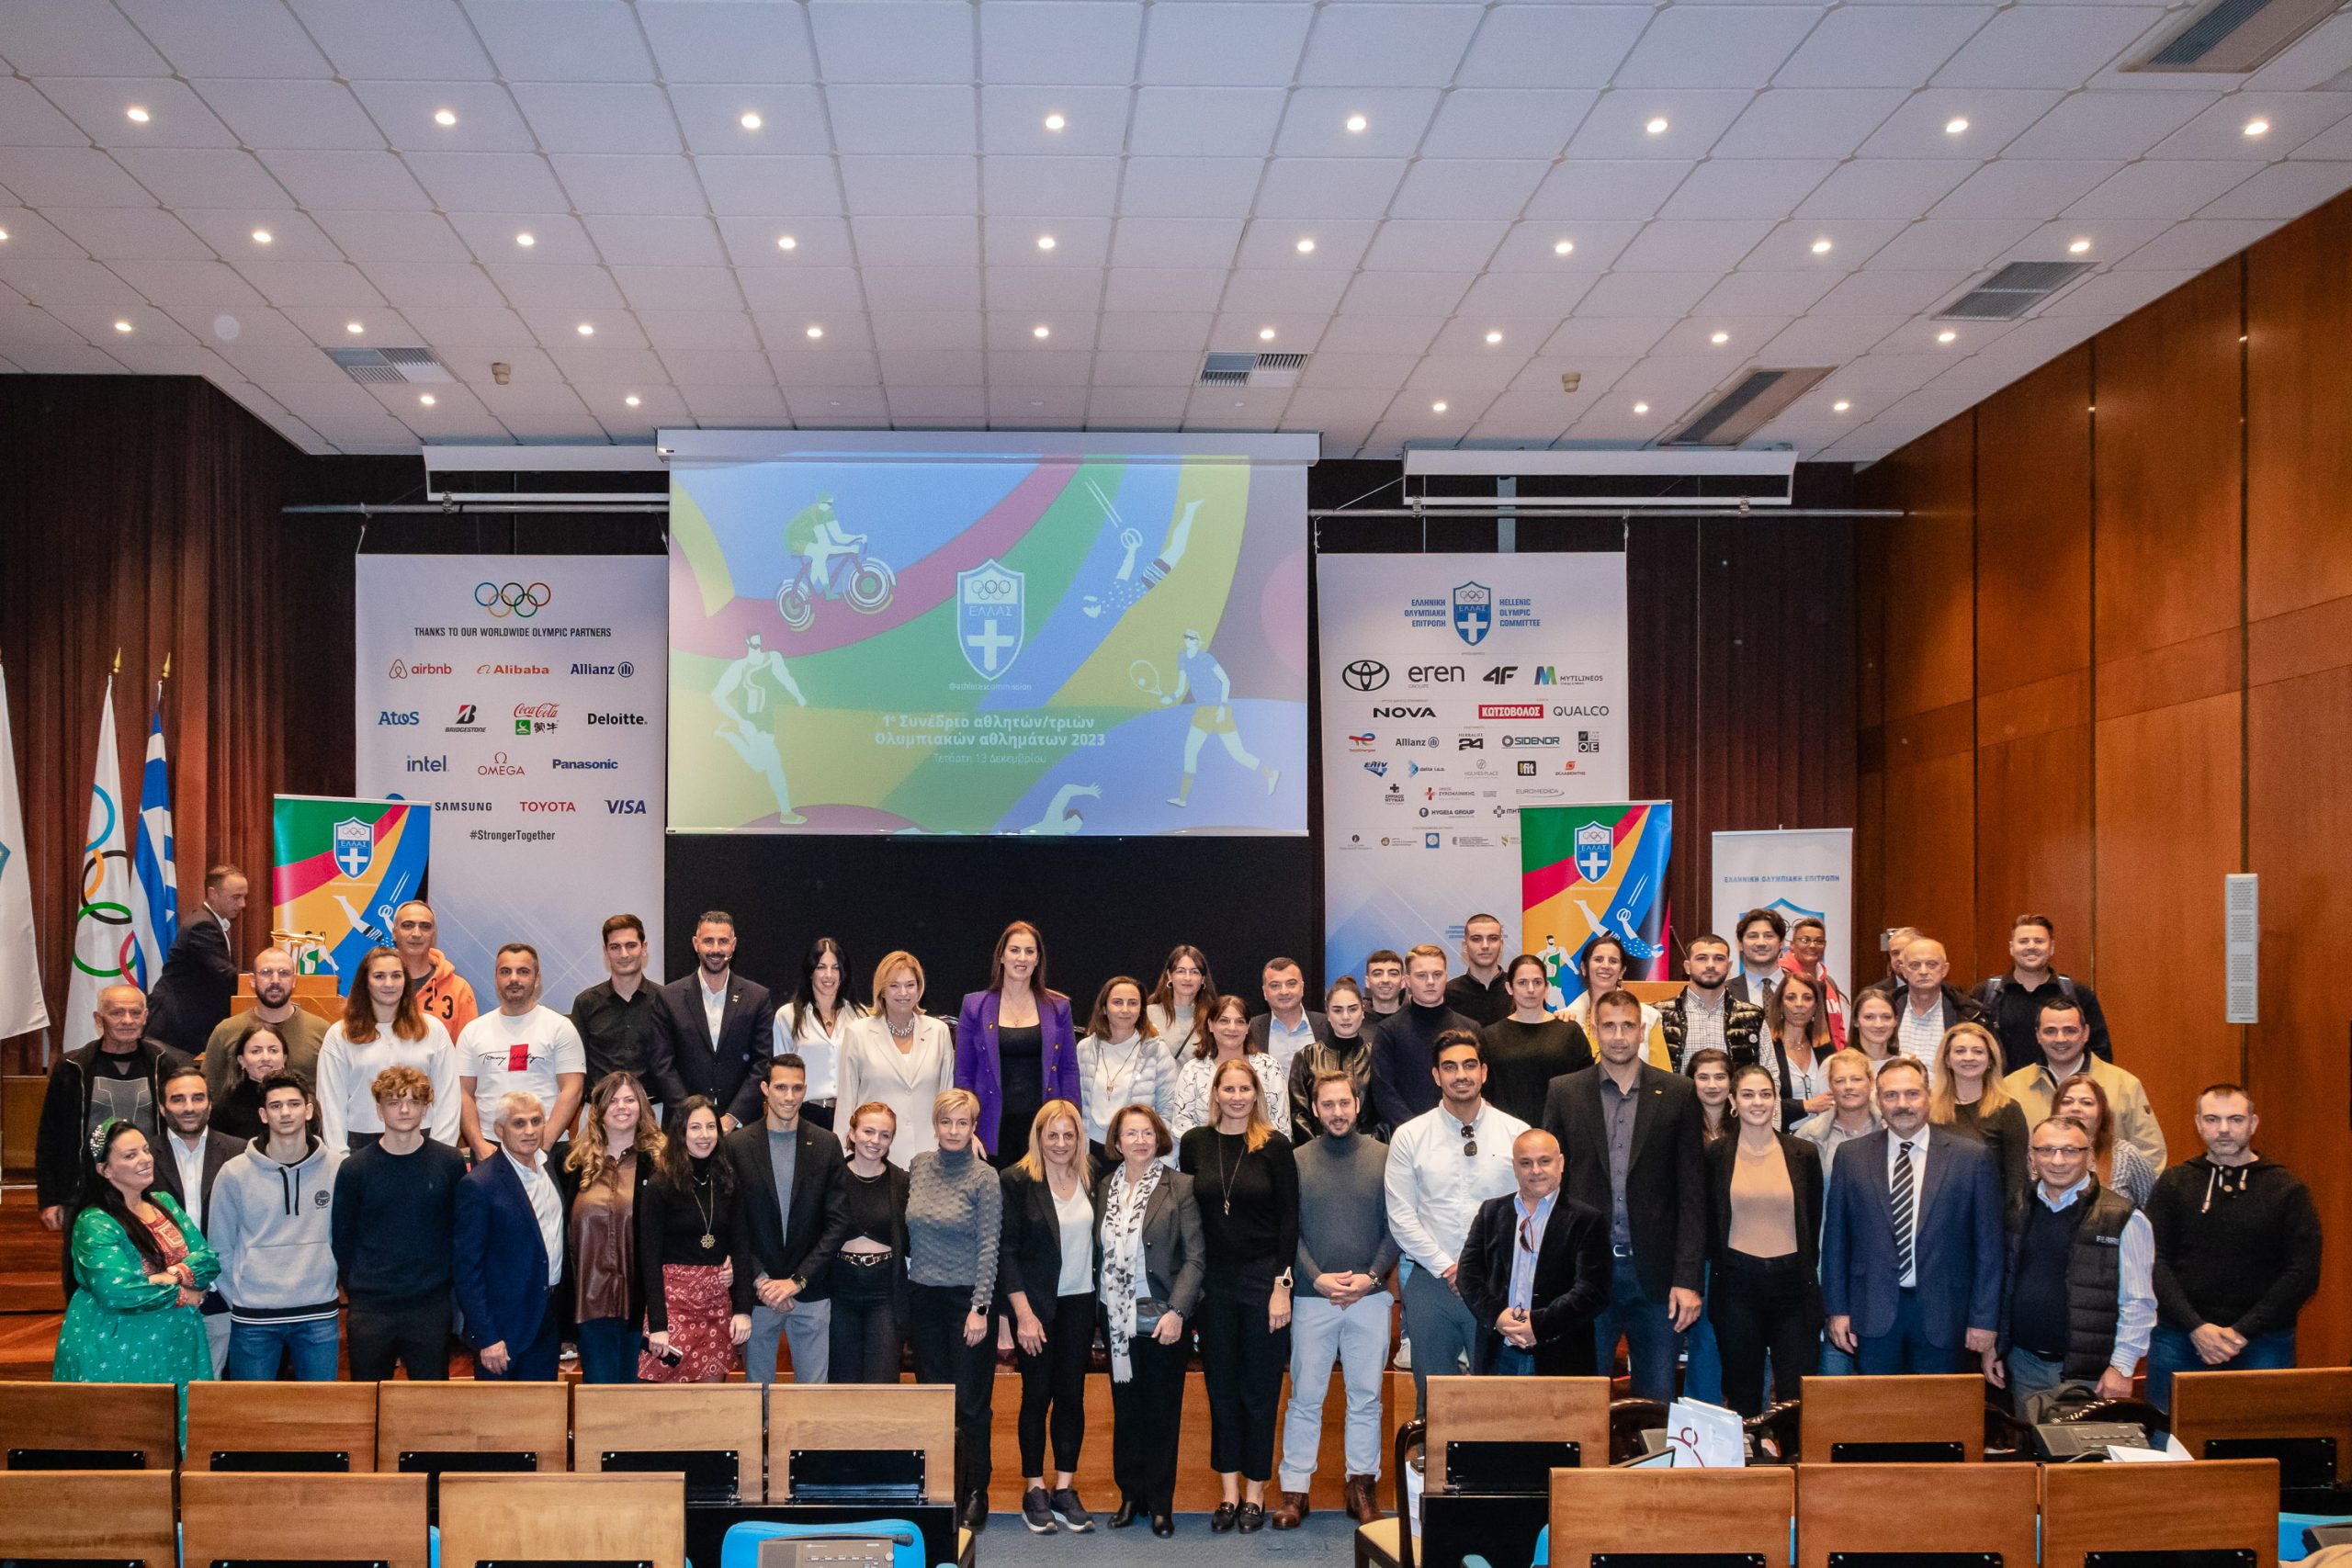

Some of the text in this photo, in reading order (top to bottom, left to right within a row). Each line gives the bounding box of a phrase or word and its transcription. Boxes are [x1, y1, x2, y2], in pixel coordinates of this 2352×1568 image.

[969, 605, 1013, 617] ΕΛΛΑΣ
[1404, 609, 1446, 617] ΟΛΥΜΠΙΑΚΗ
[1499, 609, 1531, 617] OLYMPIC
[1411, 619, 1446, 627] ΕΠΙΤΡΟΠΗ
[1499, 619, 1541, 627] COMMITTEE
[414, 627, 612, 637] THANKS TO OUR WORLDWIDE OLYMPIC PARTNERS
[411, 662, 453, 675] airbnb
[493, 664, 549, 675] Alibaba
[570, 663, 616, 675] Allianz
[1408, 665, 1465, 682] eren
[1482, 666, 1519, 685] 4F
[1373, 706, 1437, 718] NOVA
[1481, 705, 1541, 718] ΚΩΤΣΟΒΟΛΟΣ
[1553, 705, 1610, 716] QUALCO
[899, 714, 969, 731] Συνέδριο
[974, 713, 1095, 731] αθλητών/τριών
[875, 732, 1106, 750] Ολυμπιακών αθλημάτων 2023
[1395, 738, 1426, 747] Allianz
[1458, 738, 1484, 751] 24
[1514, 737, 1560, 746] SIDENOR
[552, 758, 619, 770] Panasonic
[933, 752, 1047, 765] Τετάρτη 13 Δεκεμβρίου
[478, 765, 526, 776] OMEGA
[435, 801, 492, 812] SAMSUNG
[520, 801, 576, 813] TOYOTA
[604, 799, 647, 815] VISA
[469, 829, 556, 842] #StrongerTogether
